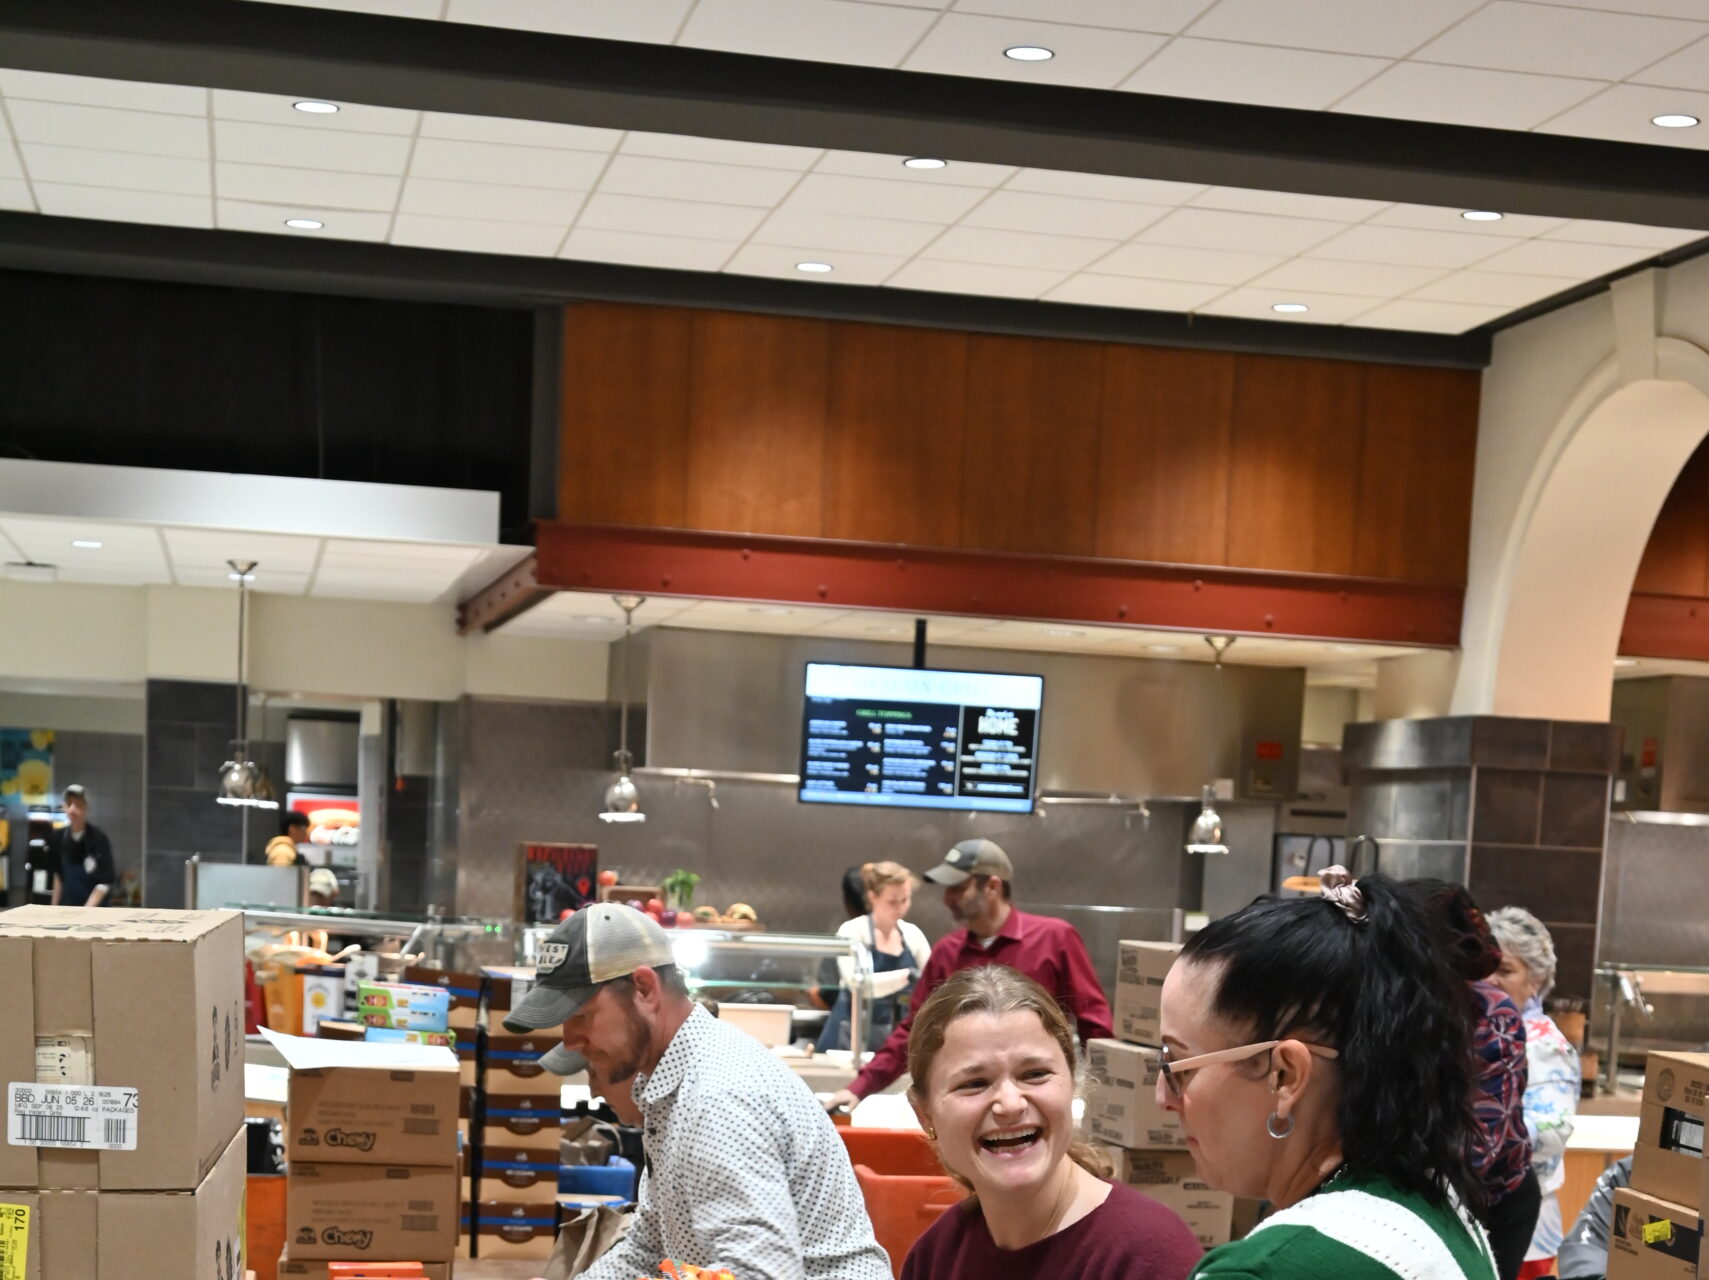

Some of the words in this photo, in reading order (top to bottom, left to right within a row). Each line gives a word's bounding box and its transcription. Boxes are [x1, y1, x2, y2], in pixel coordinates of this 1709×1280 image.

[15, 1094, 35, 1102] BBD
[41, 1096, 59, 1104] JUN
[65, 1096, 77, 1105] 05
[83, 1097, 94, 1105] 26
[324, 1128, 377, 1152] Chewy
[14, 1209, 25, 1231] 170
[322, 1226, 373, 1250] Chewy
